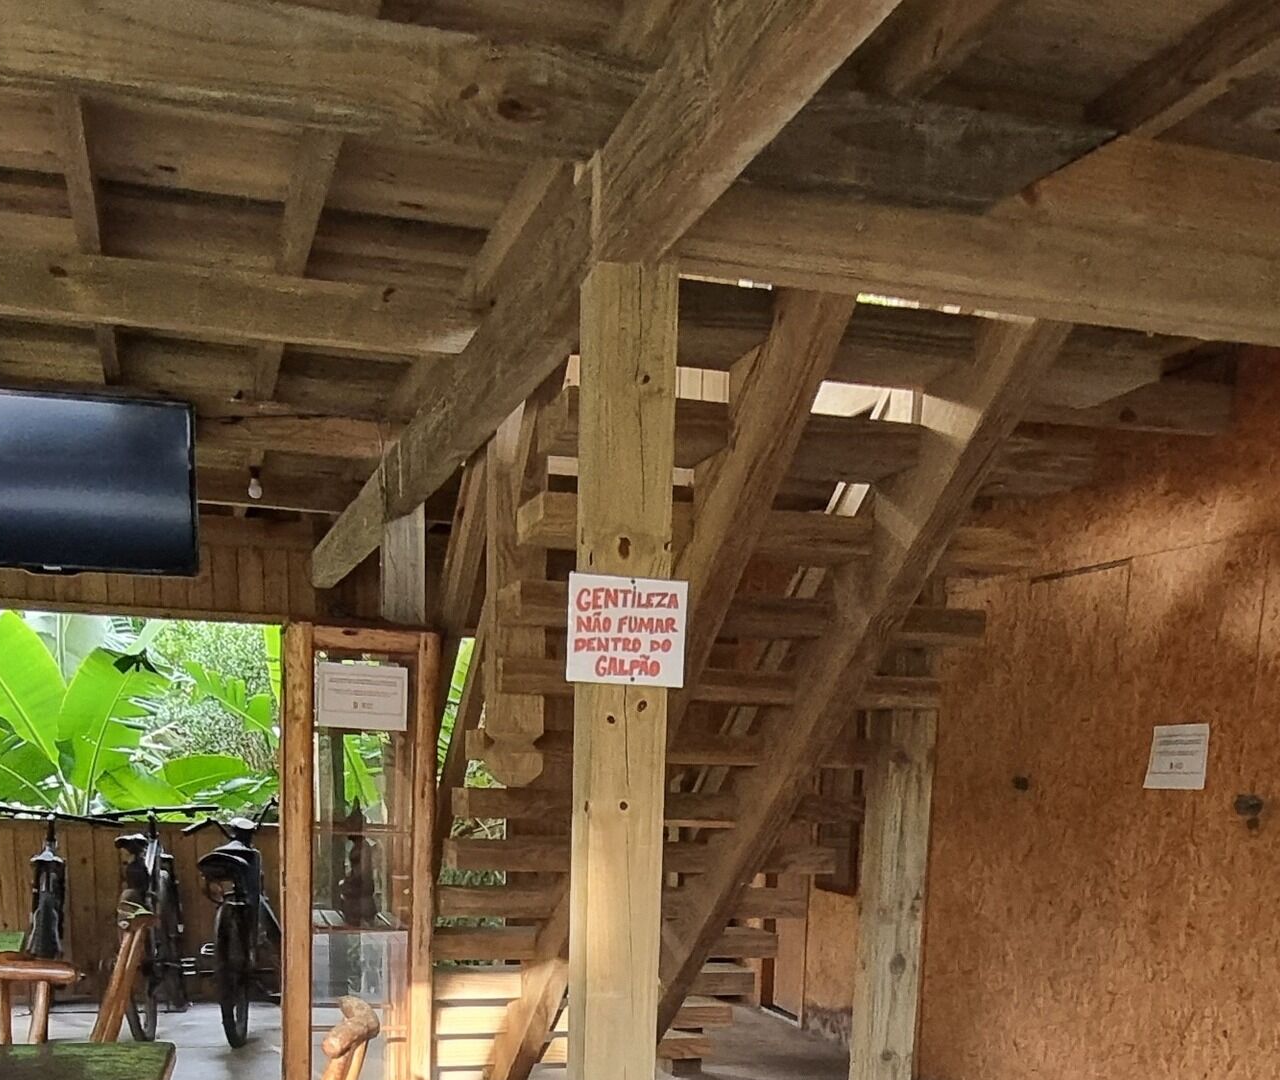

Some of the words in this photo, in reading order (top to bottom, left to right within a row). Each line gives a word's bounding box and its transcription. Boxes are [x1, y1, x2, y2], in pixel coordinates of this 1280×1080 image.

[576, 586, 679, 611] GENTILEZA
[576, 613, 611, 633] NÃO
[617, 616, 679, 634] FUMAR
[574, 637, 642, 653] DENTRO
[650, 639, 672, 652] DO
[595, 654, 661, 677] GALPÃO
